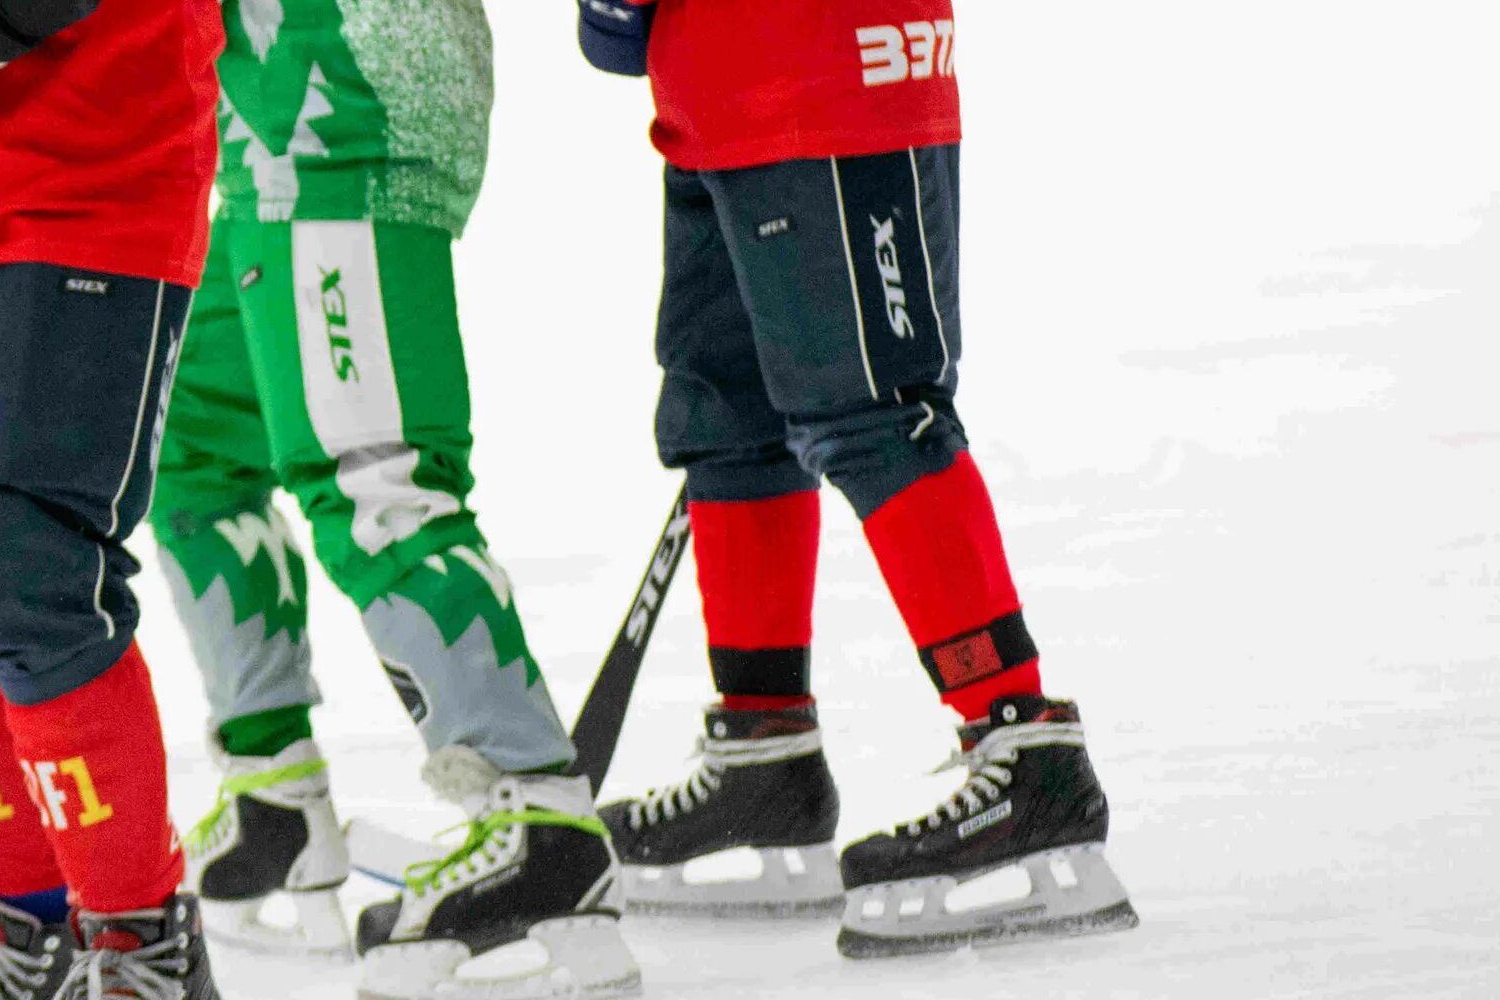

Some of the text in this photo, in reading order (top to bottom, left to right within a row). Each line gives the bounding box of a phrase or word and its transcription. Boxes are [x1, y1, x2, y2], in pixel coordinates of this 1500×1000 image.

[65, 277, 109, 295] STEX
[316, 262, 361, 385] STEX
[869, 212, 916, 341] STEX
[626, 500, 691, 648] STEX
